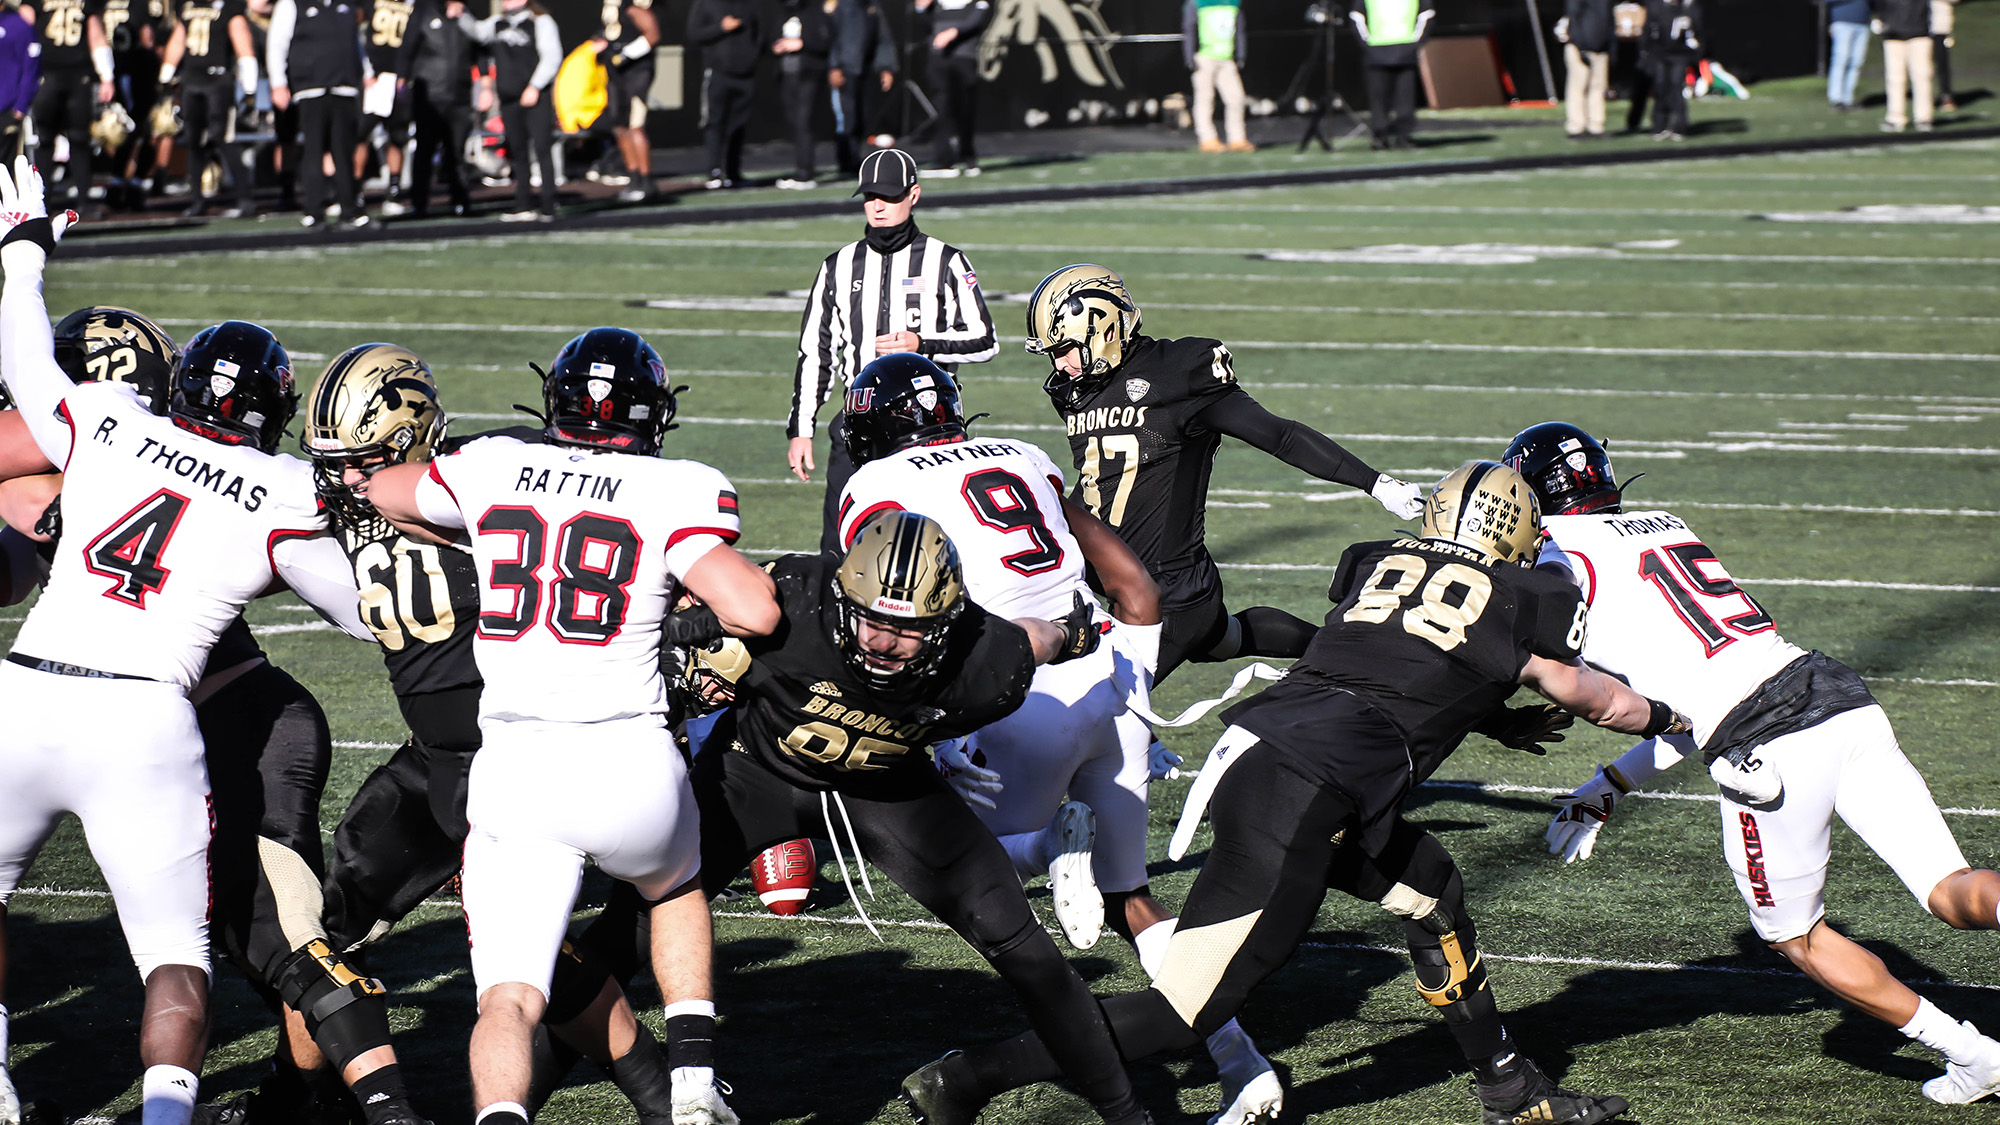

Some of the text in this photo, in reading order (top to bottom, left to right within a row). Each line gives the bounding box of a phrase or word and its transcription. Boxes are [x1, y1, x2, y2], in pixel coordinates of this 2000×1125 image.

[45, 7, 83, 46] 46
[372, 9, 409, 48] 90
[852, 279, 863, 292] S
[906, 307, 921, 328] C
[86, 346, 139, 391] 72
[1067, 405, 1149, 437] BRONCOS
[93, 415, 268, 512] R. THOMAS
[907, 444, 1021, 470] RAYNER
[515, 467, 622, 502] RATTIN
[960, 467, 1064, 577] 9
[1604, 516, 1686, 537] THOMAS
[82, 487, 192, 611] 4
[356, 535, 455, 650] 60
[475, 504, 644, 646] 38
[878, 599, 912, 612] Riddell
[1343, 554, 1493, 652] 88
[1637, 541, 1777, 659] 15
[809, 685, 843, 698] adidas
[801, 695, 935, 742] BRONCOS
[1739, 753, 1763, 774] 15
[1739, 811, 1776, 907] HUSKIES
